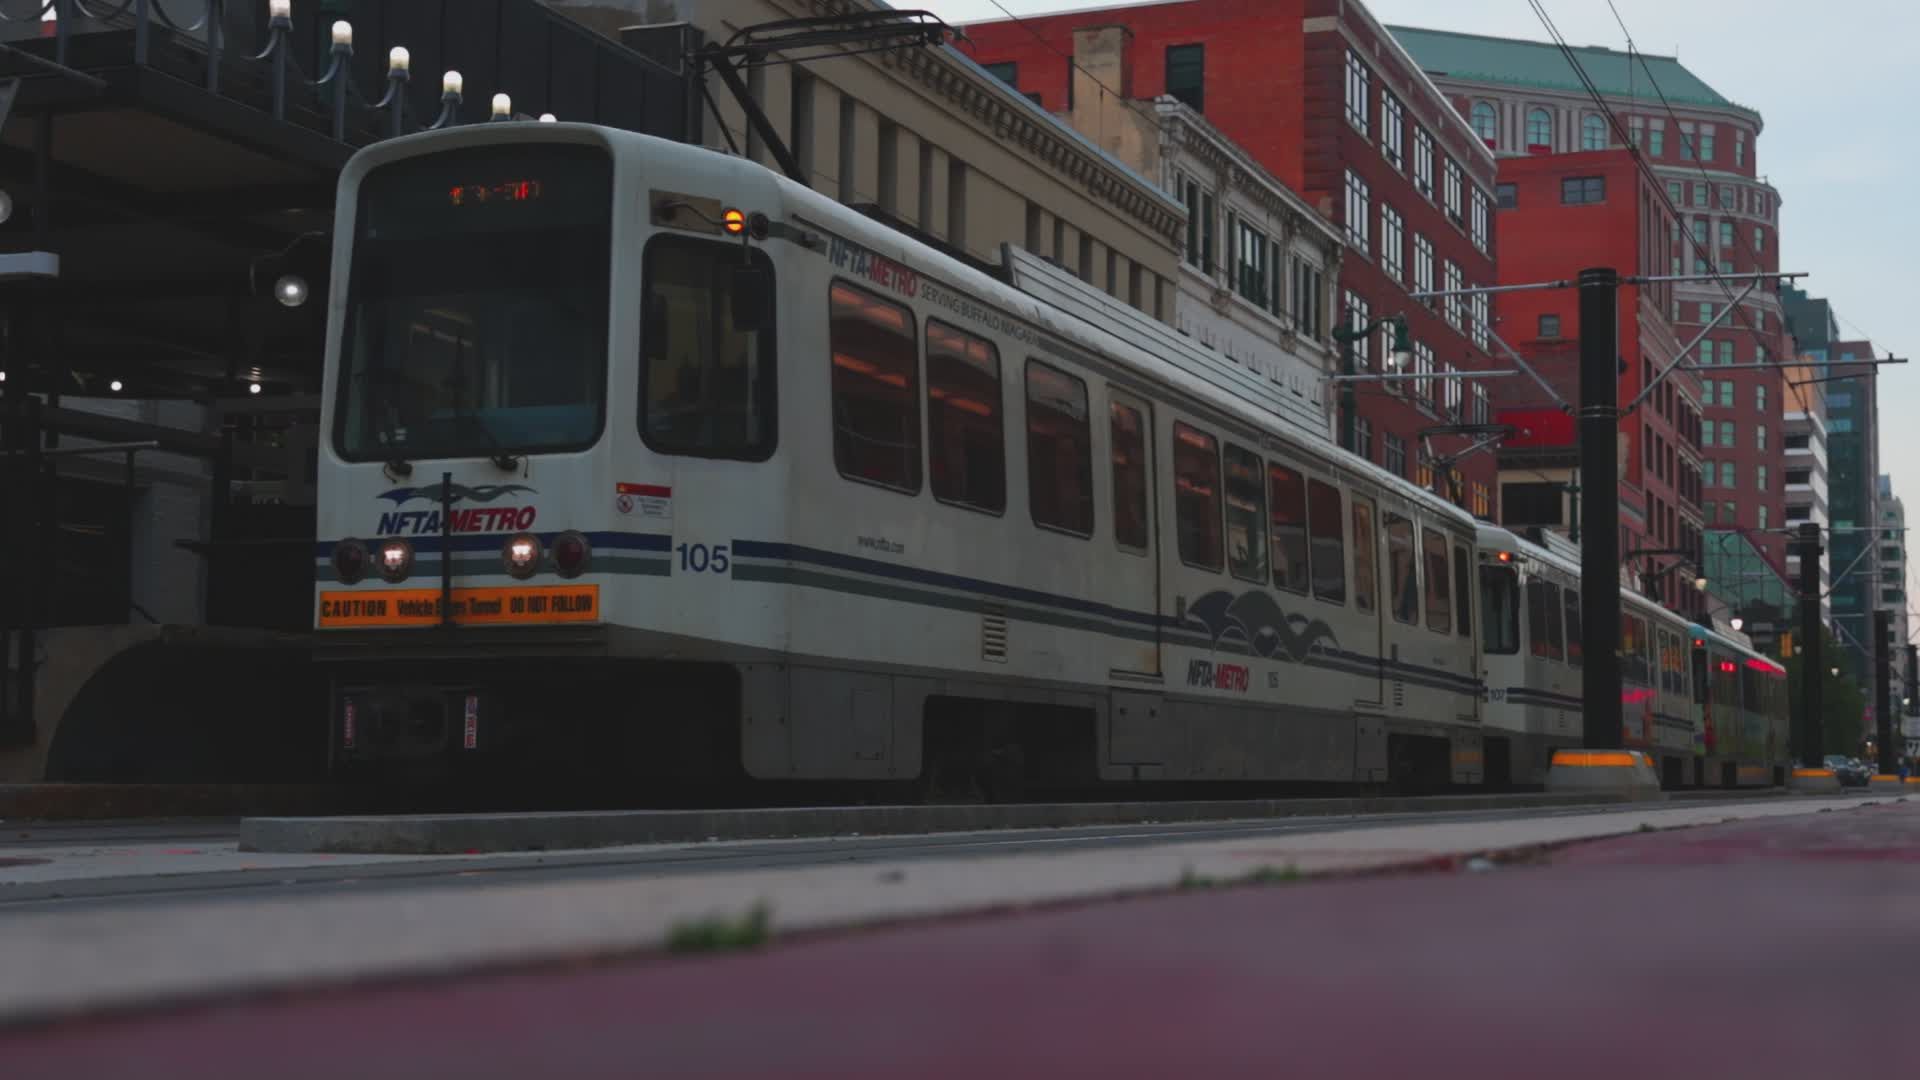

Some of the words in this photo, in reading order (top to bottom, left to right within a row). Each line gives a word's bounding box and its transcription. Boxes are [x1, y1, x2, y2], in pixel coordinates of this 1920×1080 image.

[828, 238, 918, 297] NFTA-METRO
[921, 282, 960, 312] SERVING
[960, 303, 1001, 331] BUFFALO
[376, 505, 537, 536] NFTA-METRO
[676, 542, 729, 574] 105
[322, 599, 387, 618] CAUTION
[397, 598, 433, 617] Vehicle
[510, 595, 524, 614] DO
[527, 594, 547, 614] NOT
[551, 593, 593, 613] FOLLOW
[1186, 657, 1250, 695] NFTA-METRO
